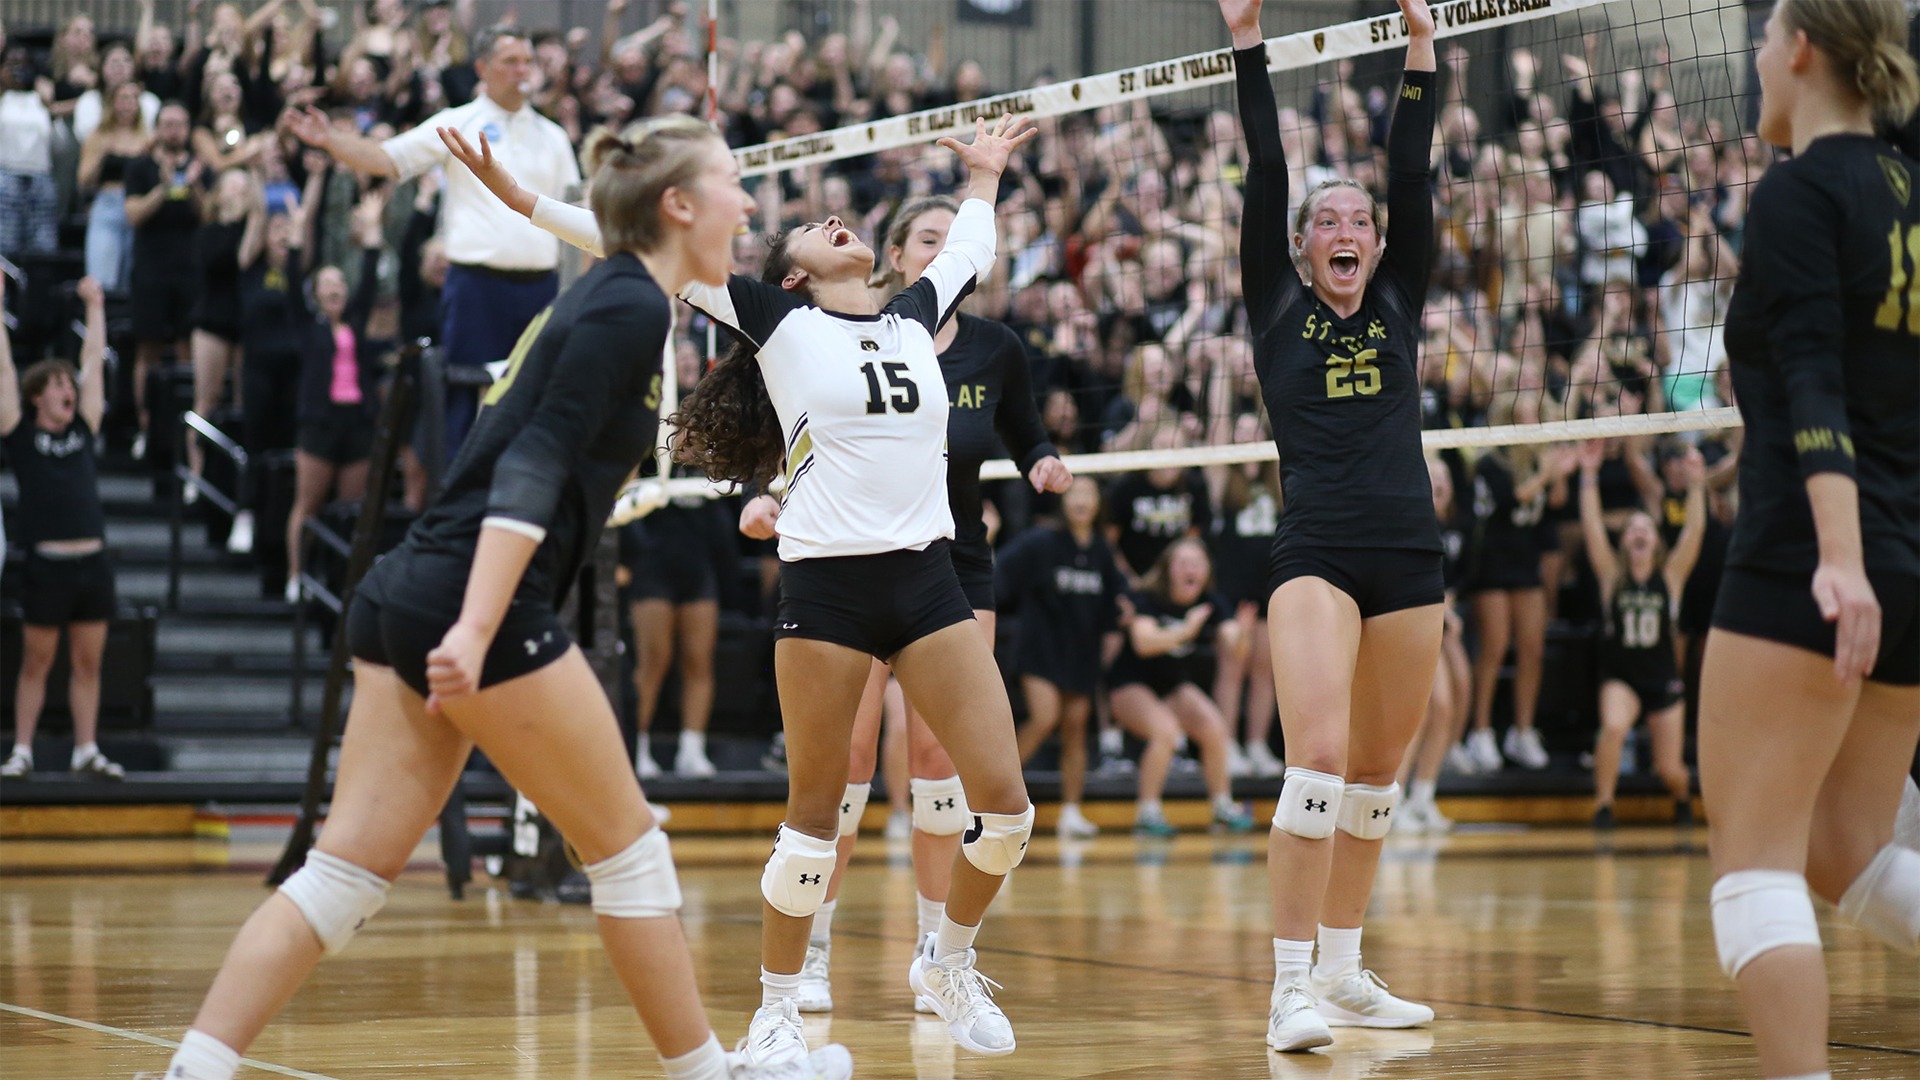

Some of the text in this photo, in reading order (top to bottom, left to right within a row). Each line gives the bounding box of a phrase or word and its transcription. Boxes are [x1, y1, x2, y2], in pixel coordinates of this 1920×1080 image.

[1370, 0, 1551, 43] ST. OF VOLLEYBA
[859, 361, 920, 415] 15
[1326, 348, 1382, 398] 25
